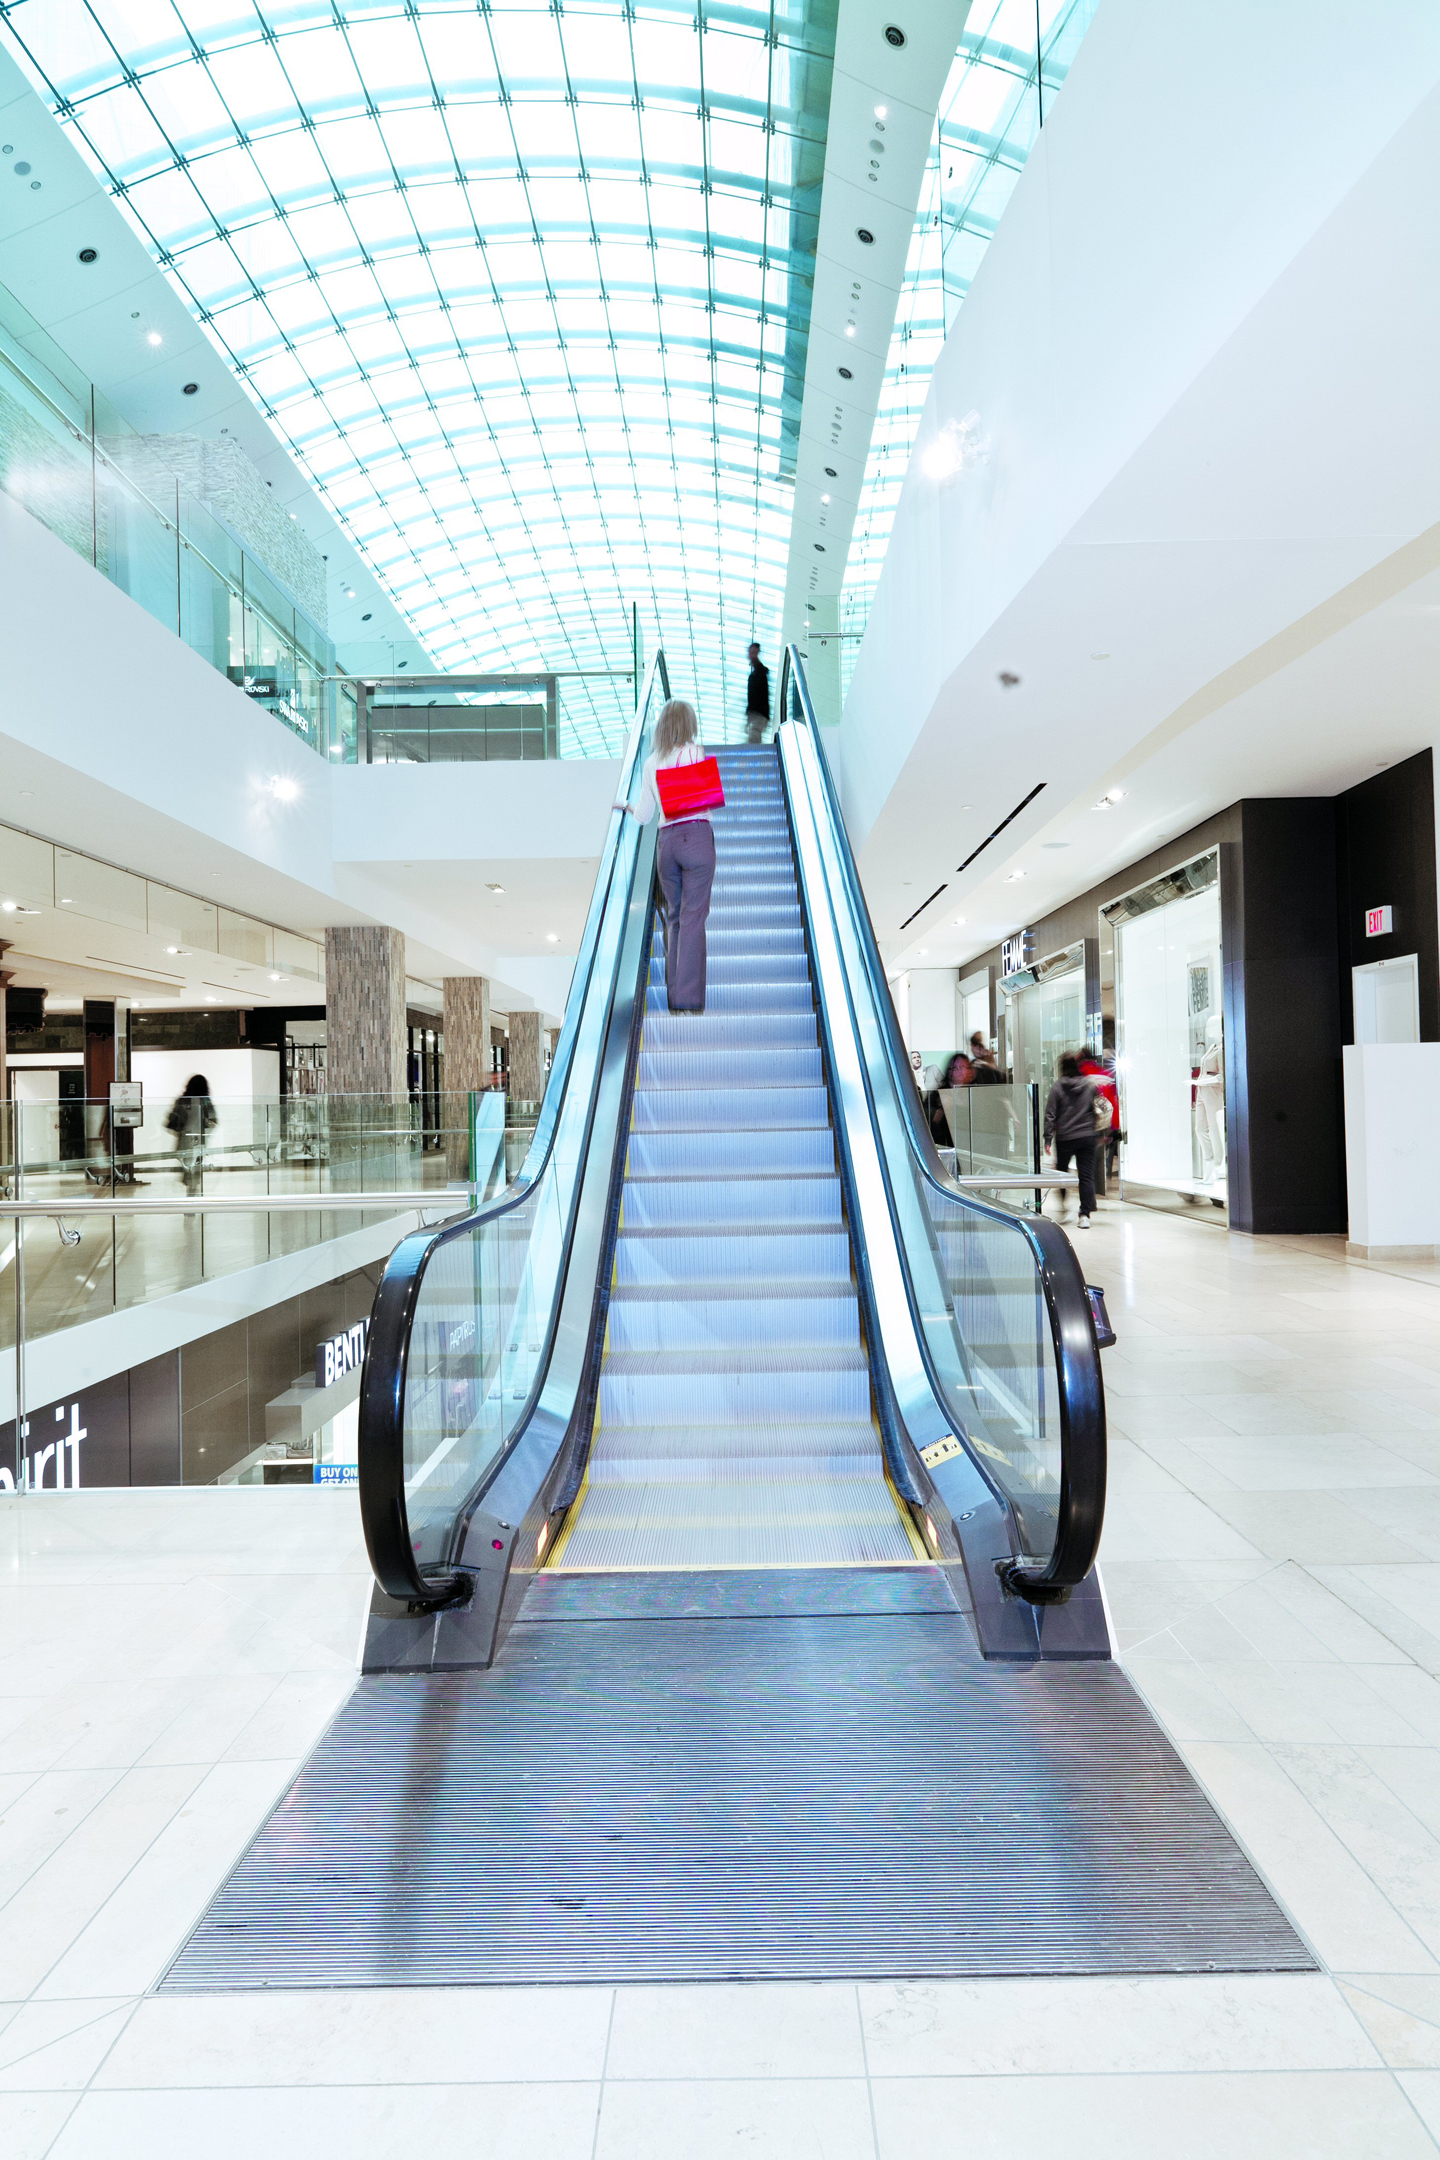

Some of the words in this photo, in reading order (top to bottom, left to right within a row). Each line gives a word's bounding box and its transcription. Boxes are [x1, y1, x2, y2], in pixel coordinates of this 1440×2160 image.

[1369, 909, 1383, 933] EXIT
[324, 1317, 371, 1388] BENTL
[924, 1435, 947, 1449] CAUTION
[320, 1467, 341, 1478] BUY
